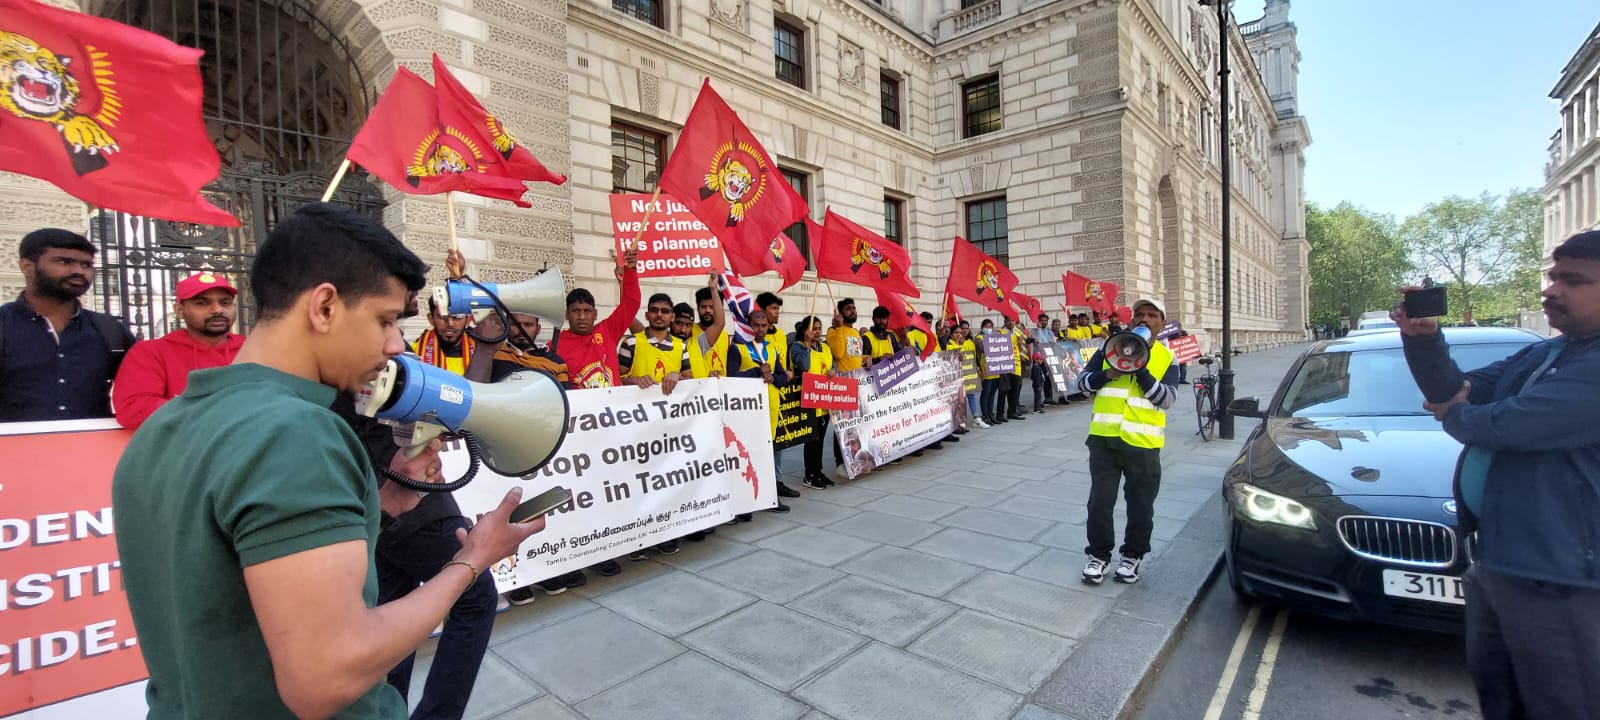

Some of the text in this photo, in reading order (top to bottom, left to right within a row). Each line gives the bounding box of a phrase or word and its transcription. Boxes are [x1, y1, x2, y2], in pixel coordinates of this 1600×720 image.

[631, 199, 690, 215] Not jus
[616, 221, 650, 232] war
[653, 236, 719, 253] planned
[636, 255, 711, 274] genocide
[780, 386, 791, 394] Sri
[814, 380, 828, 390] Tamil
[804, 391, 809, 400] is
[810, 392, 820, 403] the
[821, 394, 833, 403] only
[867, 385, 908, 403] Acknowledge
[779, 400, 801, 411] cause
[568, 403, 649, 434] vaded
[778, 412, 808, 428] ocide is
[839, 417, 861, 430] Where
[863, 413, 875, 423] are
[876, 408, 888, 419] the
[872, 424, 901, 440] Justice
[901, 416, 912, 428] for
[602, 433, 696, 465] ongoing
[603, 480, 631, 502] in
[0, 506, 113, 549] DEN
